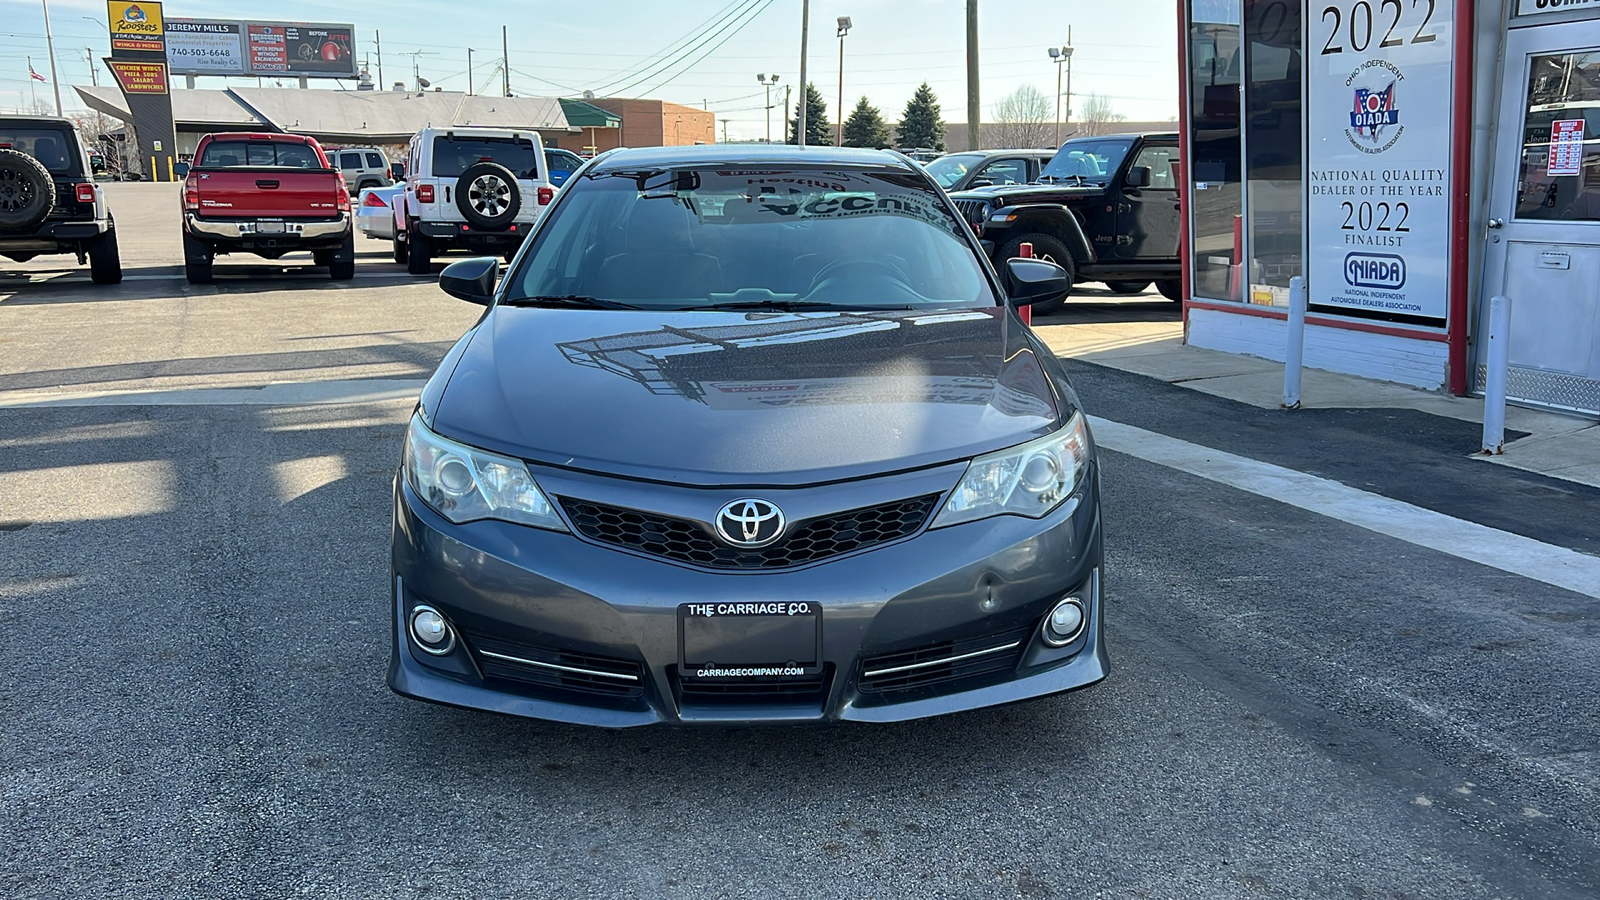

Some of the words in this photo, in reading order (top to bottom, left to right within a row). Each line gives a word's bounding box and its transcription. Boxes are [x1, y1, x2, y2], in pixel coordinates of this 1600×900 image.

[116, 20, 158, 32] Roosters
[168, 24, 201, 32] JEREMY
[1321, 0, 1436, 55] 2022
[172, 48, 230, 56] 740-503-6648
[211, 58, 228, 66] Realty
[1345, 68, 1360, 86] OHIO
[1360, 60, 1404, 82] INDEPENDENT
[1355, 112, 1390, 125] OIADA
[1344, 128, 1364, 152] AUTOMOBILE
[1382, 126, 1404, 151] ASSOCIATION
[1311, 170, 1376, 181] NATIONAL
[1382, 170, 1445, 183] QUALITY
[1313, 186, 1355, 195] DEALER
[1361, 186, 1375, 195] OF
[1380, 186, 1403, 195] THE
[1410, 186, 1442, 196] YEAR
[1341, 201, 1410, 232] 2022
[1345, 234, 1403, 246] FINALIST
[1349, 260, 1399, 282] NIADA
[1345, 289, 1369, 297] NATIONAL
[1370, 291, 1406, 300] INDEPENDENT
[1331, 296, 1361, 305] AUTOMOBILE
[1363, 299, 1384, 308] DEALERS
[1385, 302, 1422, 311] ASSOCIATION
[688, 604, 714, 615] THE
[718, 604, 786, 615] CARRIAGE
[789, 603, 811, 614] CO.
[697, 668, 804, 677] CARRIAGECOMPANY.COM
